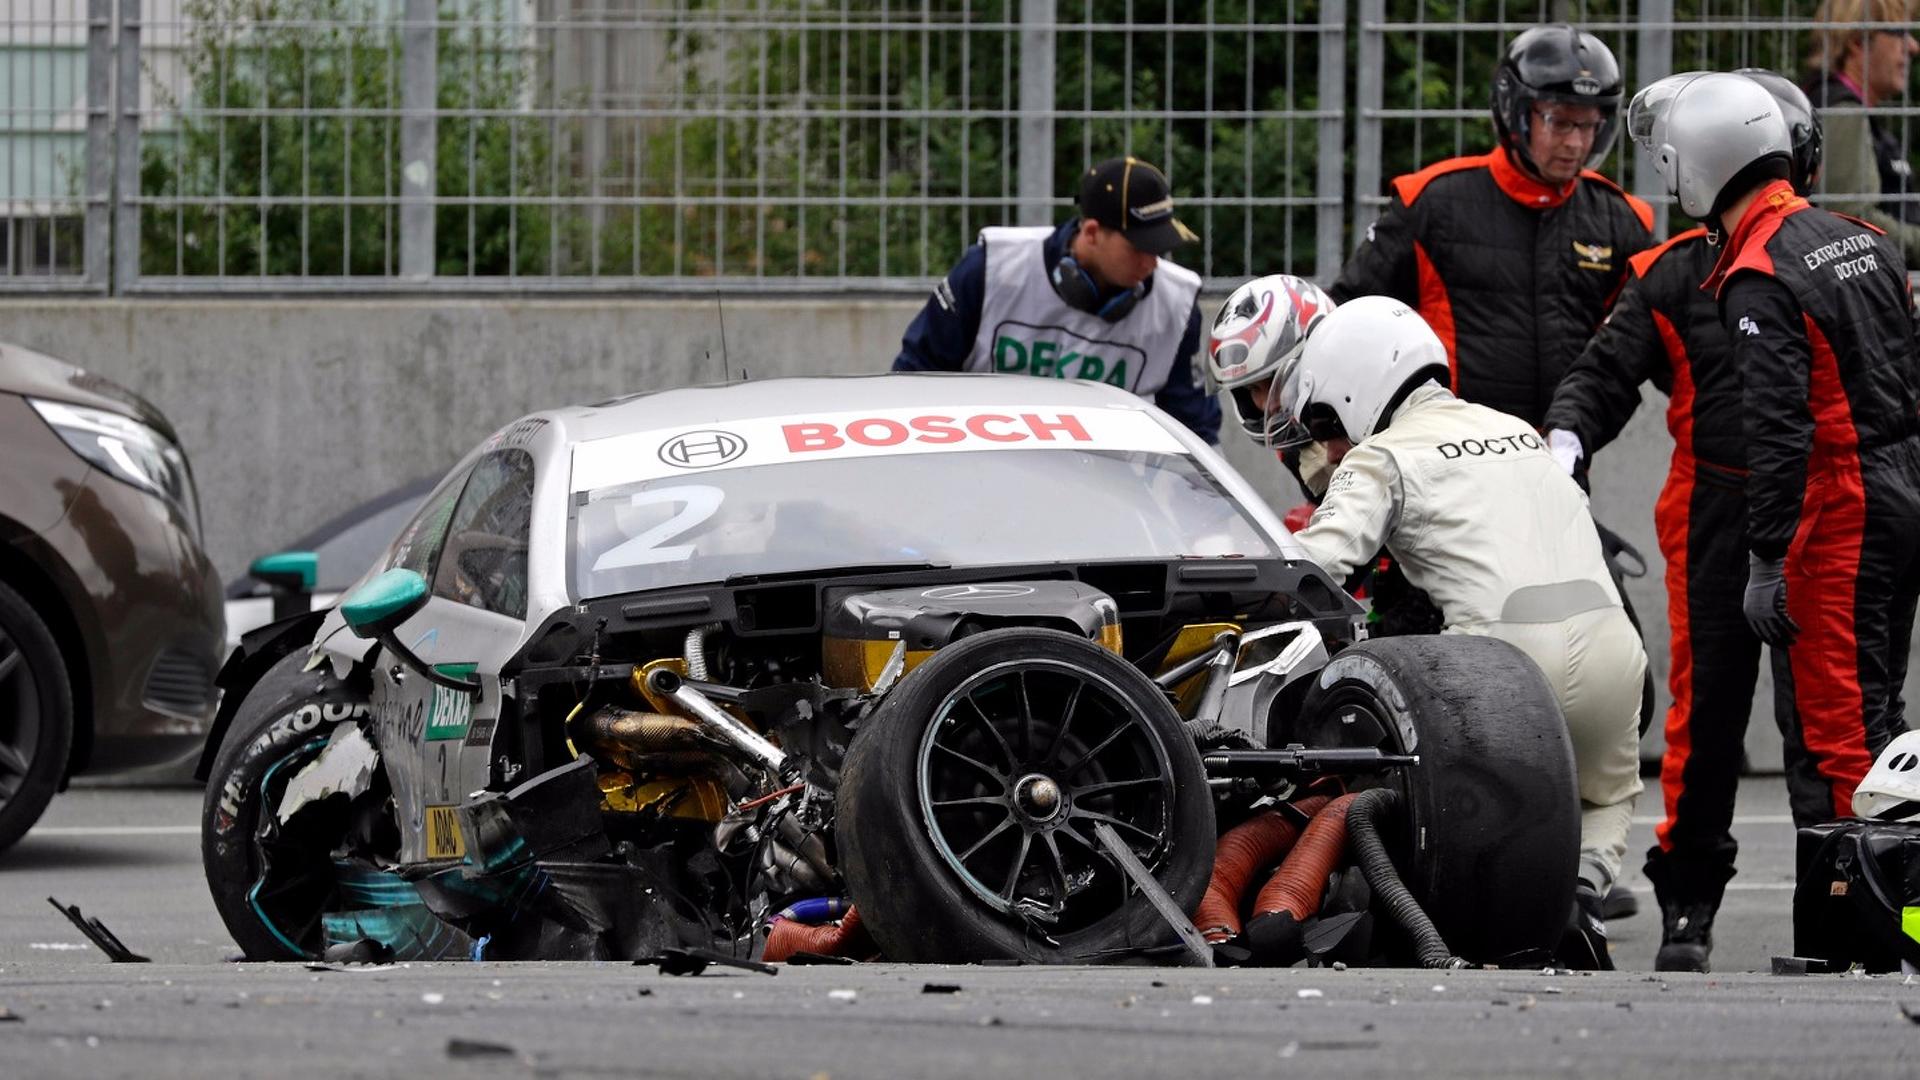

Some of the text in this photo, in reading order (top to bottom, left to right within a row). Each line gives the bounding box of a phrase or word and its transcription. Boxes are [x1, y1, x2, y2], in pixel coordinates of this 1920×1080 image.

[996, 336, 1126, 388] DEKRA
[782, 414, 1092, 453] BOSCH
[1437, 433, 1544, 459] DOCTO
[592, 486, 726, 572] 2
[432, 684, 471, 728] DEKRA
